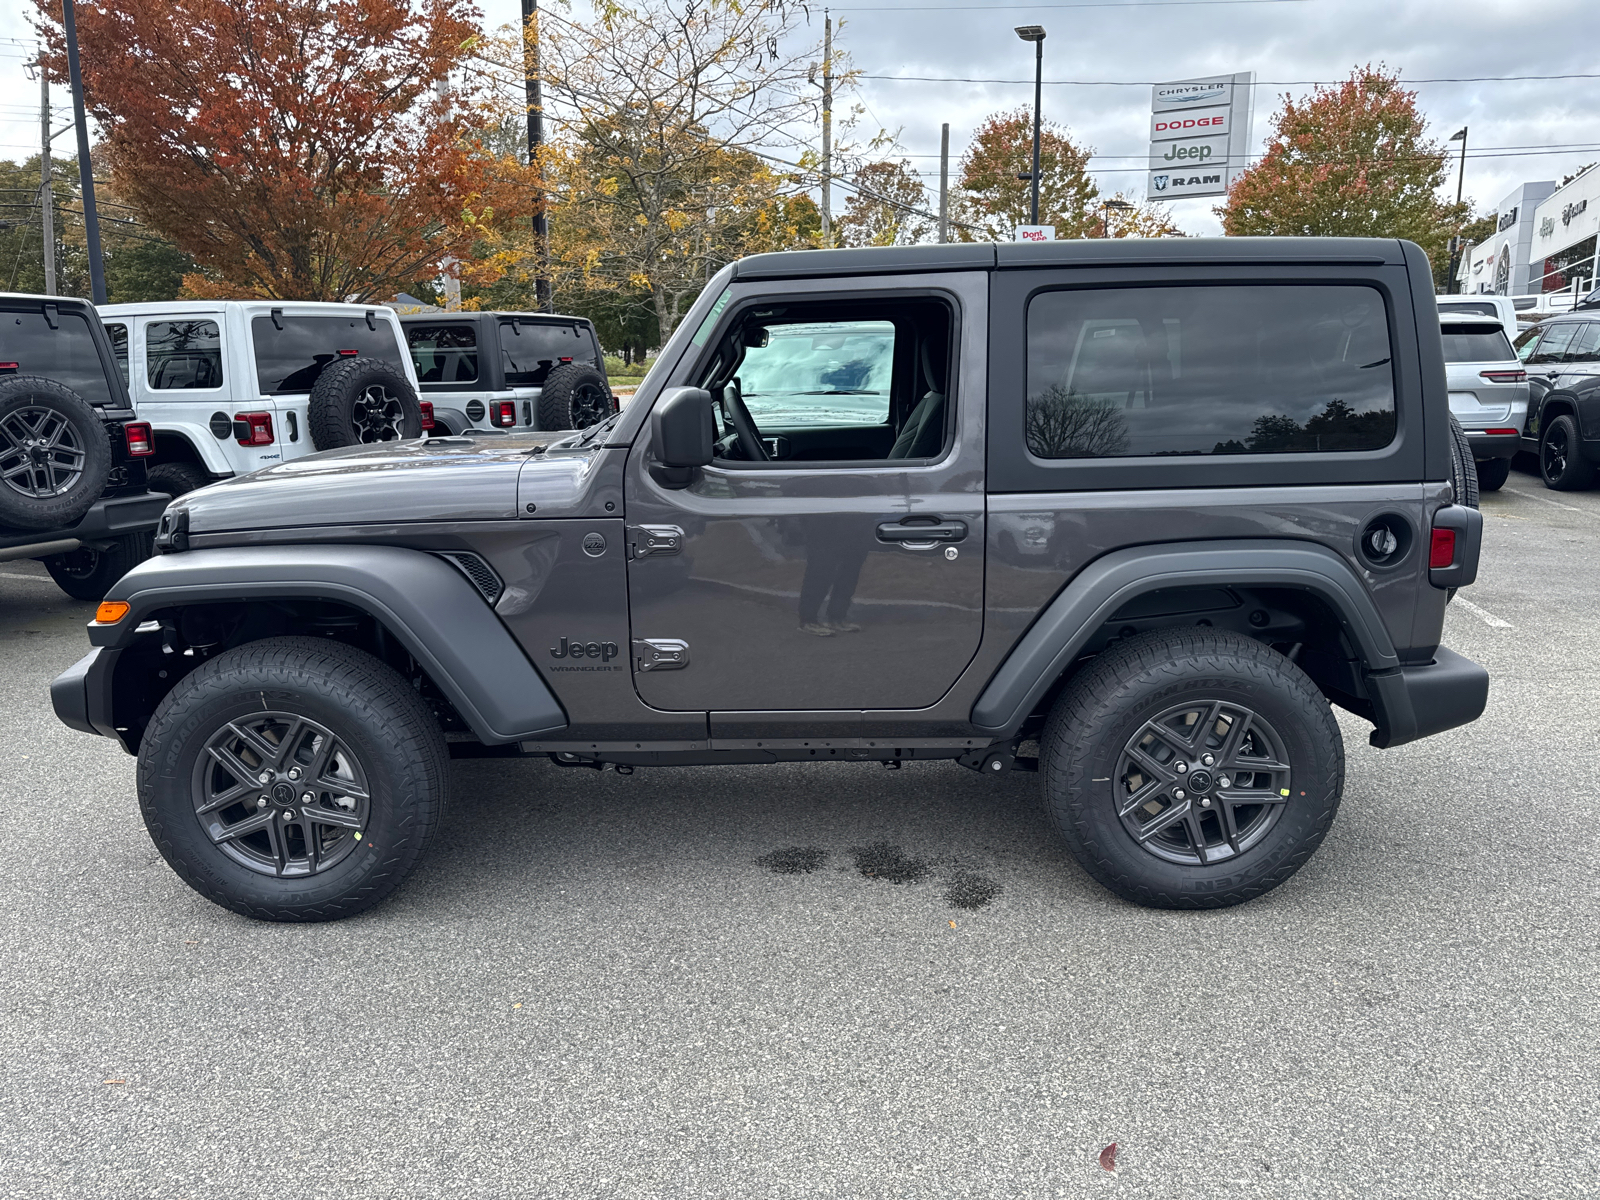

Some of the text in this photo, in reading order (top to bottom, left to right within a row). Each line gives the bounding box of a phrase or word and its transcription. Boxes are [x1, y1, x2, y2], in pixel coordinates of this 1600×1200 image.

[1158, 83, 1224, 97] CHRYSLER
[1155, 116, 1224, 132] DODGE
[1163, 144, 1212, 162] Jeep
[1172, 174, 1221, 187] RAM
[1022, 230, 1043, 239] Dont
[549, 636, 619, 663] Jeep
[166, 698, 227, 767] ROADIA
[1194, 841, 1292, 891] NEXEN
